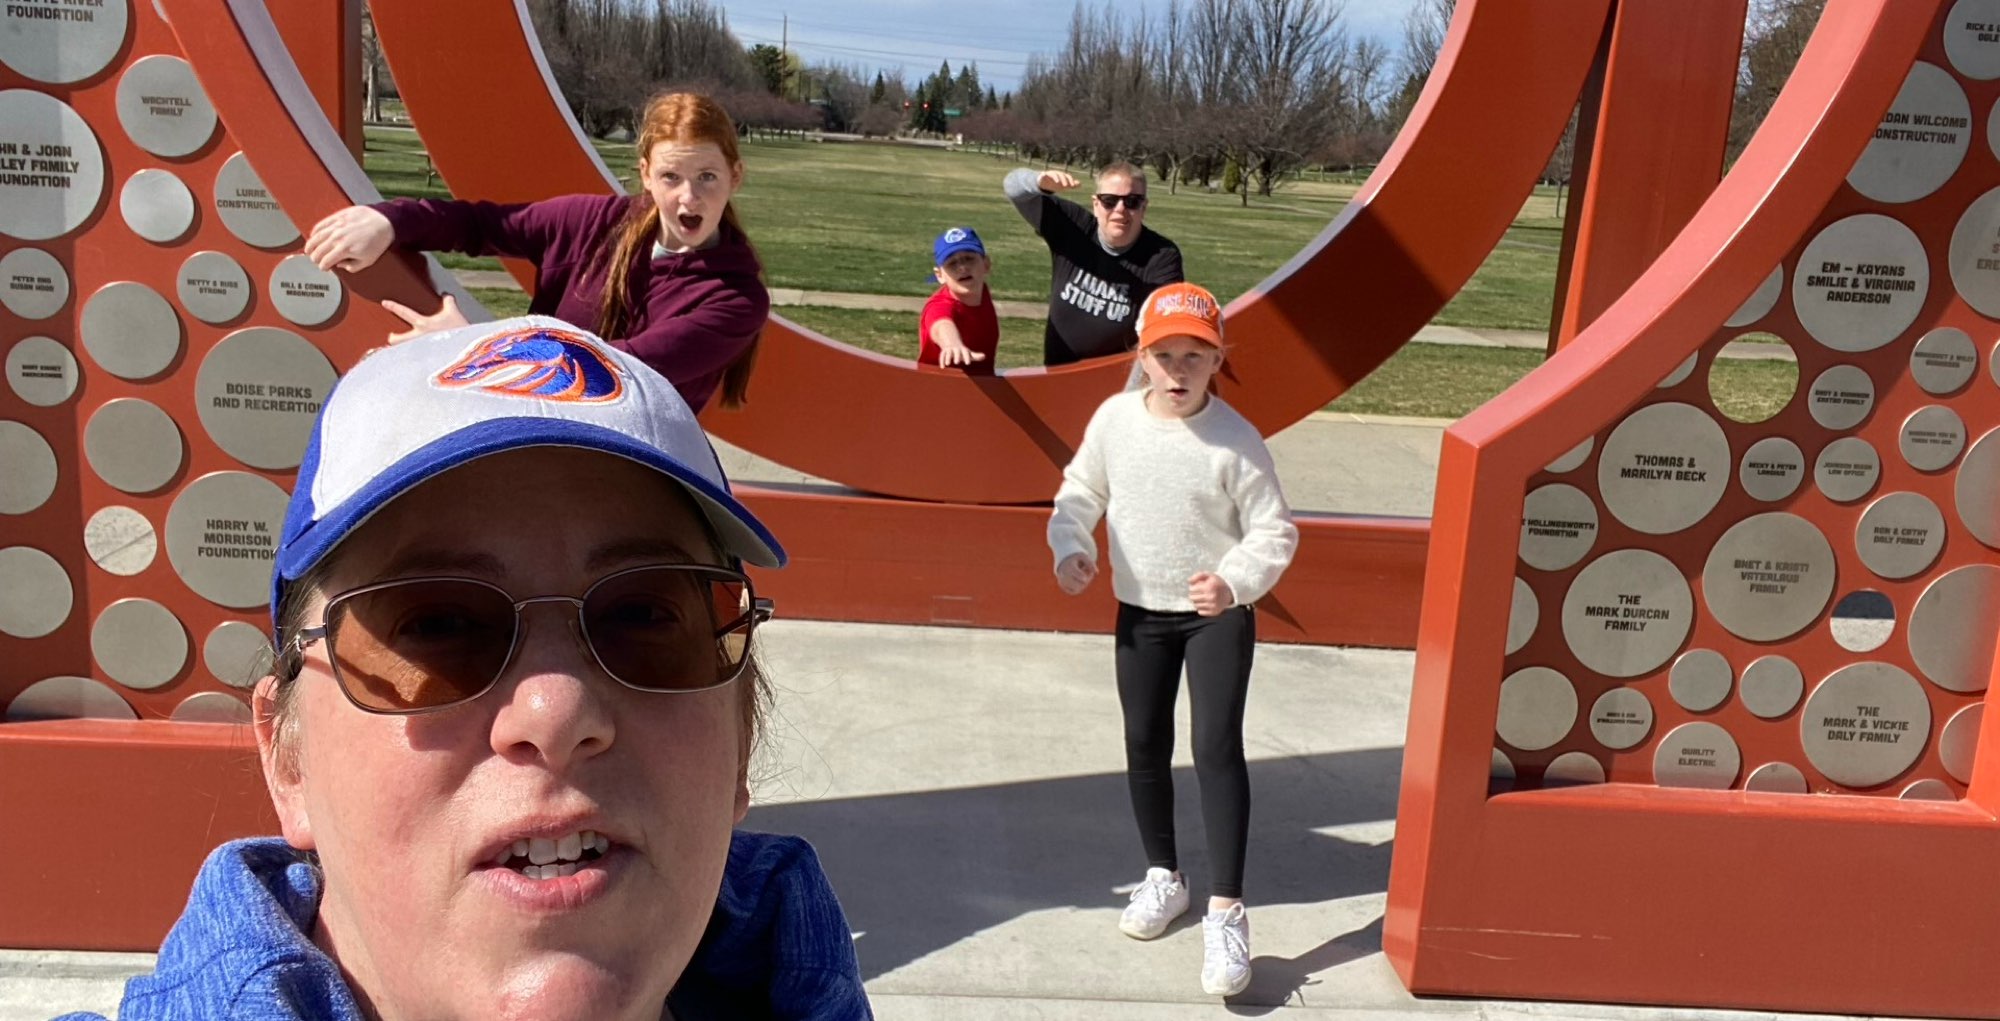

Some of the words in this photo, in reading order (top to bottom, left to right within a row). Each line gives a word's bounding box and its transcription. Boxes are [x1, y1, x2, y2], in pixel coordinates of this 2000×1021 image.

[7, 5, 94, 22] FOUNDATION
[1966, 22, 1985, 31] RICK
[150, 106, 184, 117] FAMILY
[1883, 112, 1910, 124] DAN
[1913, 114, 1968, 128] WILCOMB
[1873, 128, 1957, 144] ONSTRUCTION
[22, 144, 31, 156] &
[36, 145, 72, 158] JOAN
[31, 159, 80, 174] FAMILY
[0, 174, 71, 189] UNDATION
[216, 199, 280, 210] CONSTRUCTIO
[1822, 262, 1841, 273] EM
[1857, 264, 1905, 277] KAYANS
[1807, 276, 1849, 288] SMILIE
[1851, 278, 1860, 289] &
[1864, 278, 1916, 292] VIRGINIA
[1060, 282, 1107, 317] STUFF
[1106, 301, 1131, 322] UP
[1827, 291, 1892, 304] ANDERSON
[226, 383, 265, 396] BOISE
[269, 385, 313, 399] PARKS
[213, 397, 241, 409] AND
[1635, 454, 1685, 468] THOMAS
[1687, 457, 1696, 469] &
[1620, 468, 1673, 481] MARILYN
[1675, 470, 1707, 483] BECK
[206, 519, 249, 531] HARRY
[253, 521, 269, 532] W.
[1527, 519, 1596, 531] HOLLINGSWORTH
[204, 533, 272, 547] MORRISON
[1528, 527, 1580, 539] FOUNDATION
[1749, 583, 1788, 595] FAMILY
[1618, 594, 1642, 605] THE
[1585, 605, 1620, 618] MARK
[1622, 607, 1670, 620] DURCAN
[1604, 619, 1647, 632] FAMILY
[1857, 705, 1881, 717] THE
[1823, 716, 1857, 728] MARK
[1860, 718, 1868, 729] &
[1872, 720, 1910, 732] VICKIE
[1827, 729, 1857, 742] DALY
[1858, 731, 1901, 744] FAMILY
[1678, 757, 1717, 768] ELECTRIC
